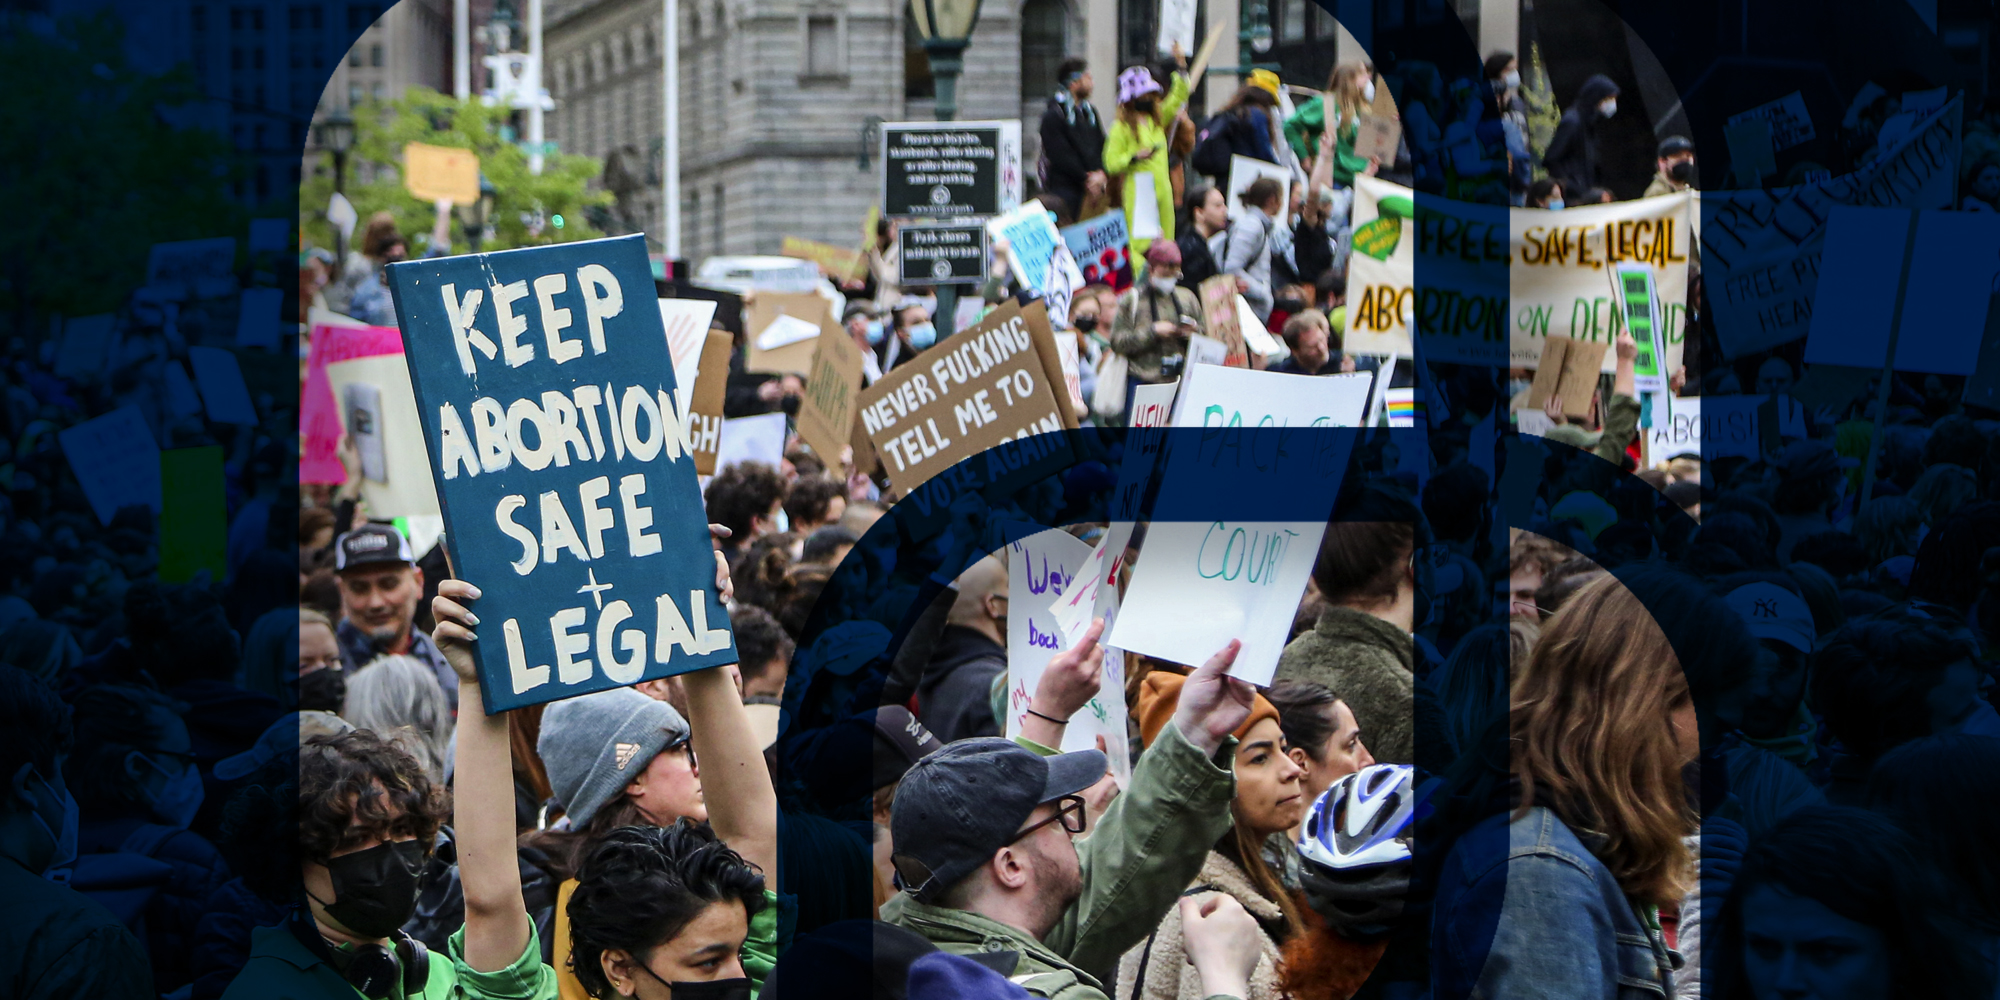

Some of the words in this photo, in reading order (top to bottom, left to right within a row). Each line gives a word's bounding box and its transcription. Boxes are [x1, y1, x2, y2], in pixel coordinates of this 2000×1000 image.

[1605, 216, 1686, 268] LEGAL
[441, 263, 623, 375] KEEP
[1354, 285, 1507, 341] ABORTION
[1518, 302, 1553, 338] ON
[861, 373, 937, 436] NEVER
[931, 315, 1031, 396] FUCKING
[884, 418, 951, 472] TELL
[954, 389, 998, 437] ME
[996, 368, 1035, 407] TO
[440, 382, 694, 480] ABORTION
[986, 412, 1066, 484] AGAIN
[496, 473, 663, 576] SAFE
[1198, 520, 1300, 586] COURT
[503, 589, 732, 695] LEGAL
